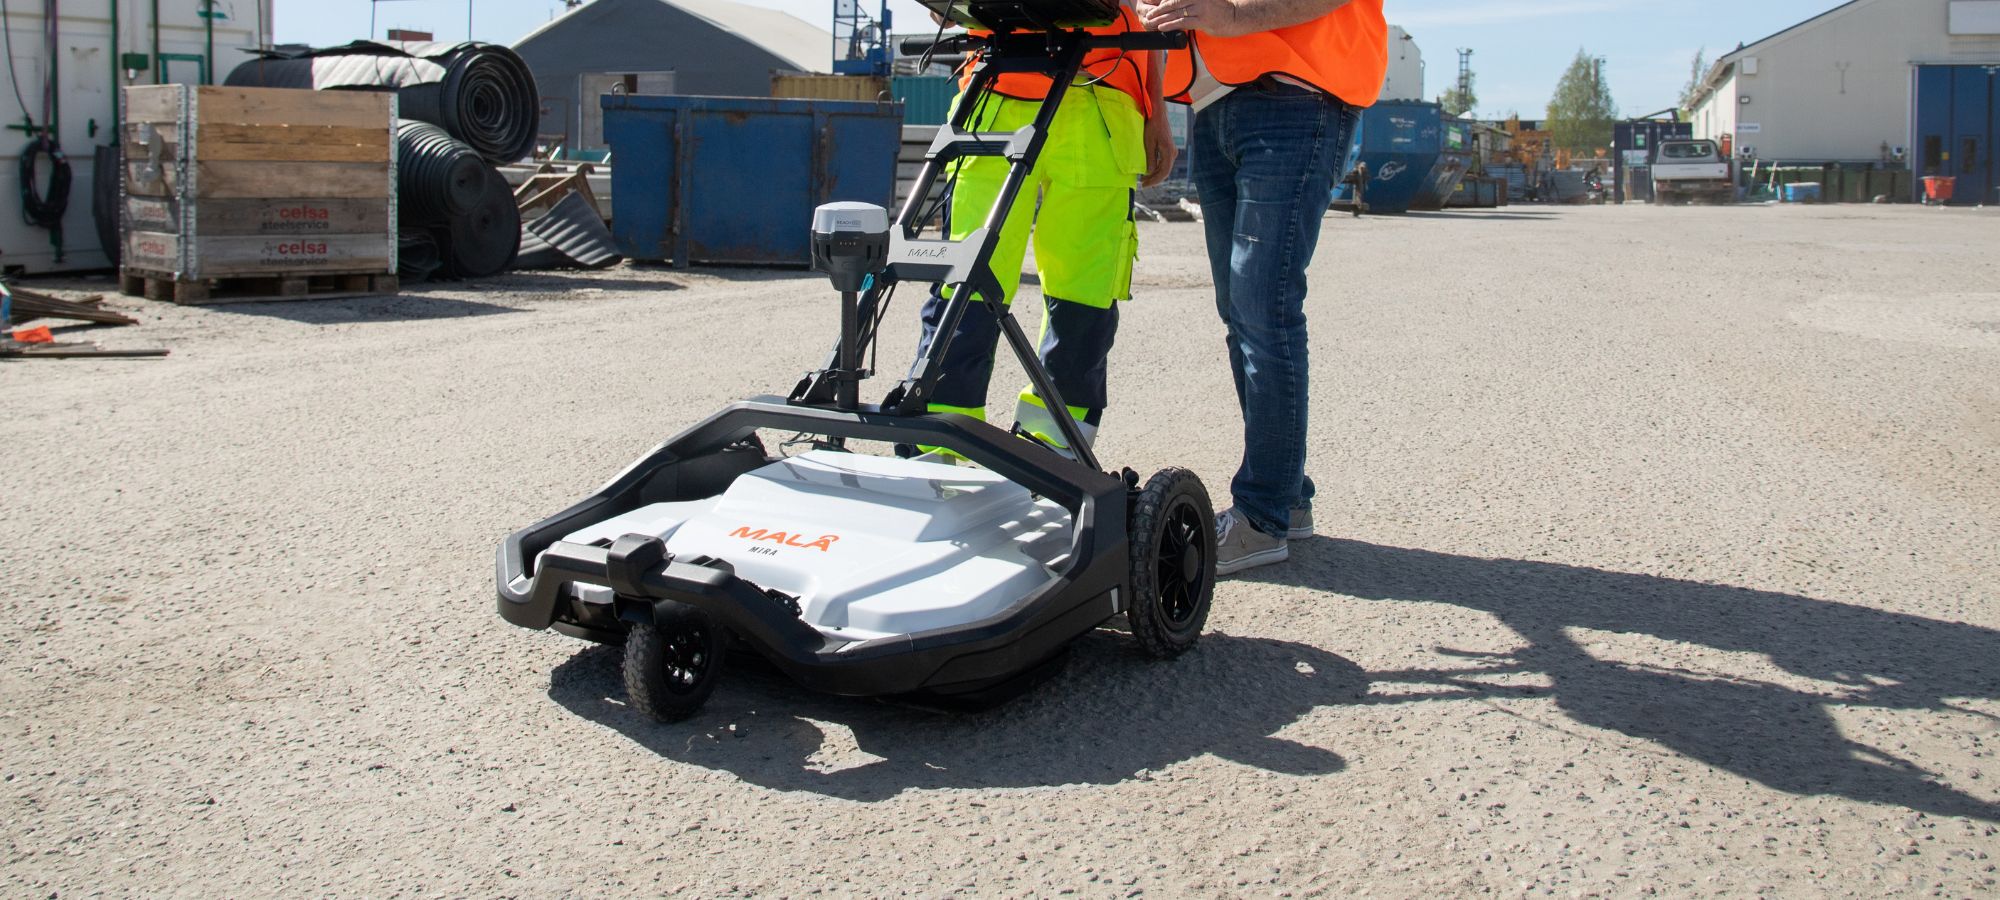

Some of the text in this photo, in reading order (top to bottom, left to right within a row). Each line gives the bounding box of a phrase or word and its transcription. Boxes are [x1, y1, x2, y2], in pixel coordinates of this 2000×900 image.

[280, 205, 328, 219] celsa
[262, 221, 328, 229] steelservice
[278, 240, 327, 255] celsa
[749, 546, 778, 556] MIRA
